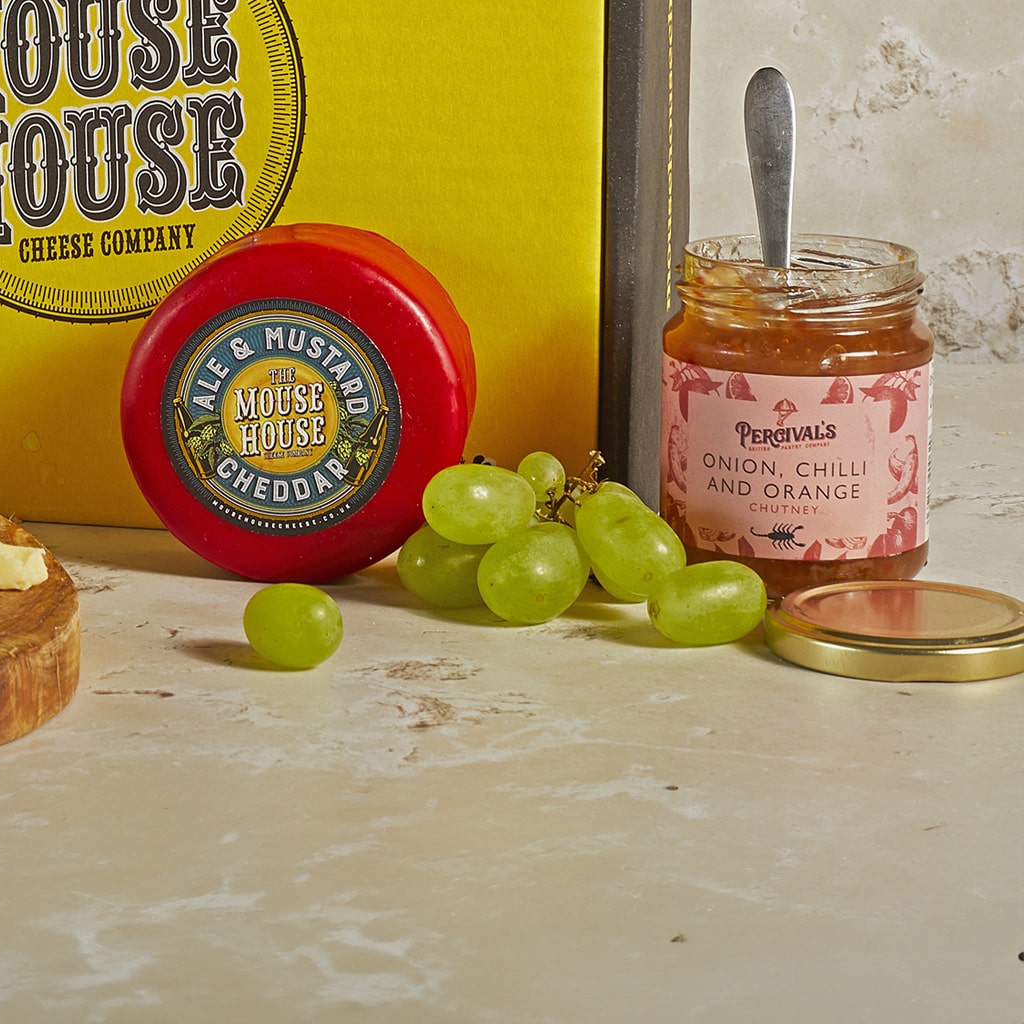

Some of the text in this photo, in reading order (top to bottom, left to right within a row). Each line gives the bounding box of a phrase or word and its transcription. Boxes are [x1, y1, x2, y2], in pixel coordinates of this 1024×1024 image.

[18, 224, 196, 264] CHEESE COMPANY
[192, 326, 370, 415] ALE & MUSTARD
[268, 367, 296, 385] THE
[234, 382, 324, 422] MOUSE
[239, 416, 326, 457] HOUSE
[735, 420, 838, 449] PERCIVAL'S
[216, 457, 349, 503] CHEDDAR
[702, 452, 867, 479] ONION, CHILLI
[706, 476, 860, 501] AND ORANGE
[749, 502, 819, 515] CHUTNEY
